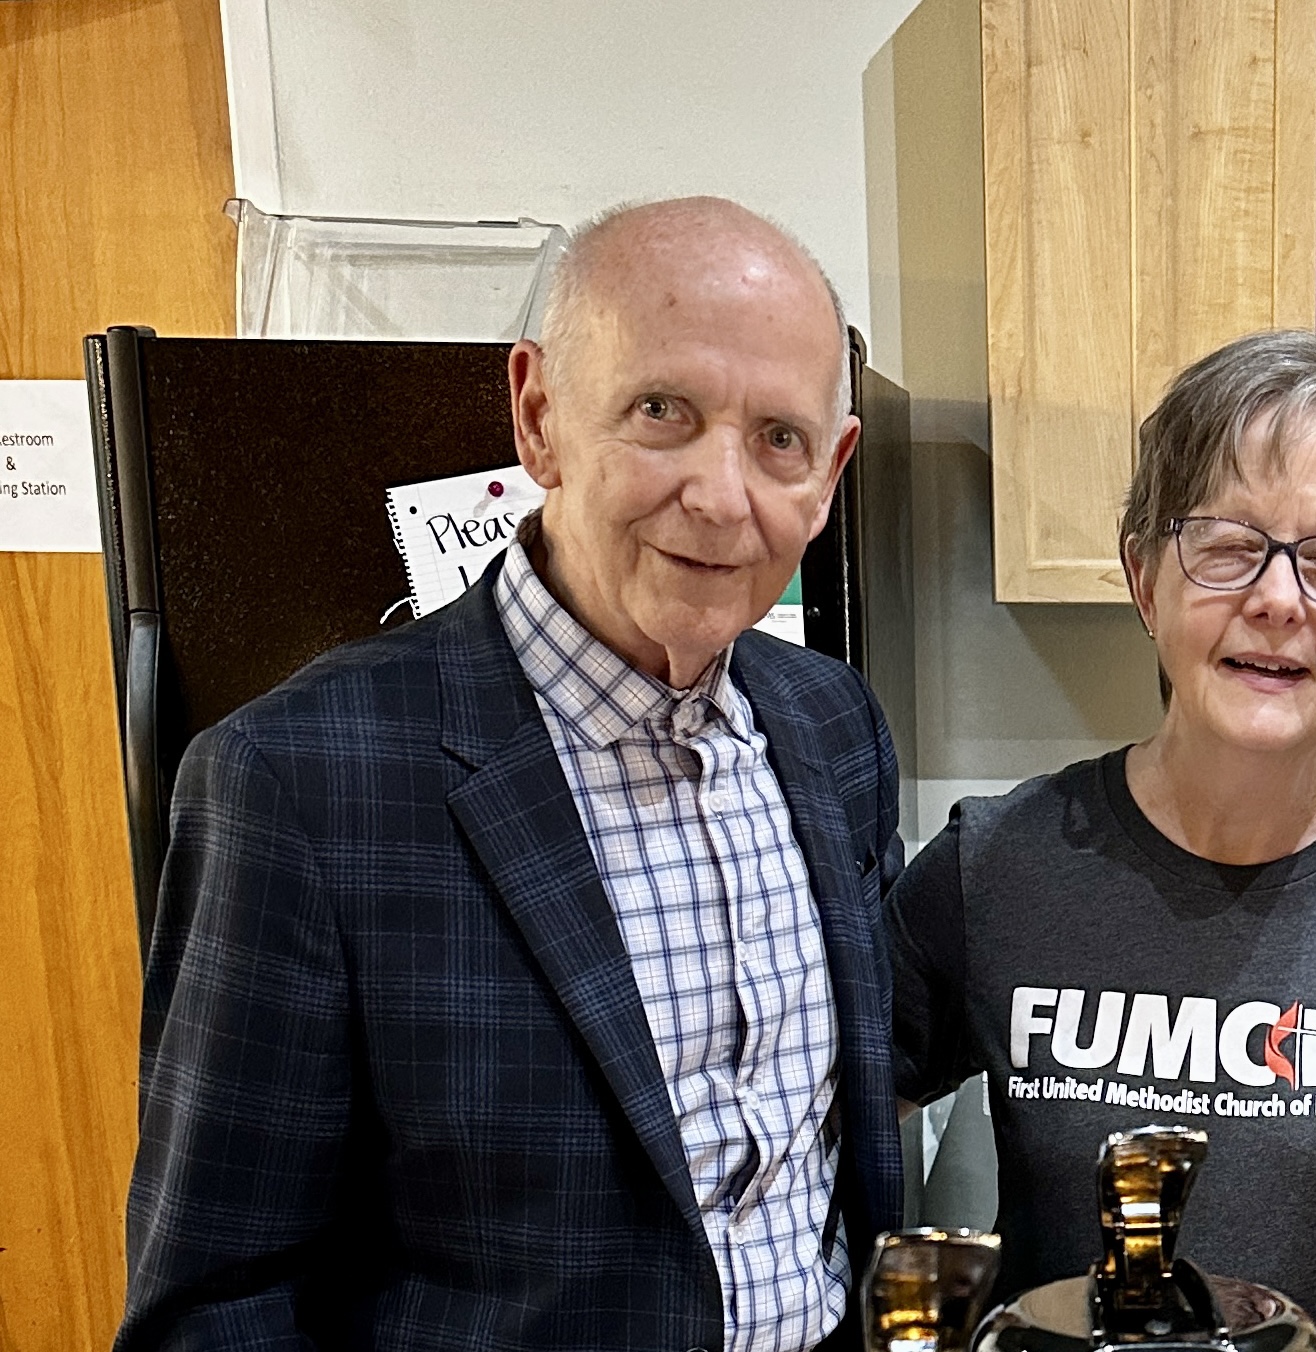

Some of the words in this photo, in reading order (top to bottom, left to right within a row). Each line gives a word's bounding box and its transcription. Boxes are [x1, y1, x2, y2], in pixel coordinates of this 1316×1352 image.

[0, 433, 54, 446] estroom
[6, 456, 17, 471] &
[0, 483, 19, 498] ing
[21, 481, 67, 495] Station
[426, 513, 516, 554] Pleas
[1008, 1076, 1040, 1101] First
[1042, 1077, 1104, 1103] United
[1105, 1083, 1211, 1116] Methodist
[1214, 1092, 1286, 1119] Church
[1289, 1094, 1313, 1117] of
